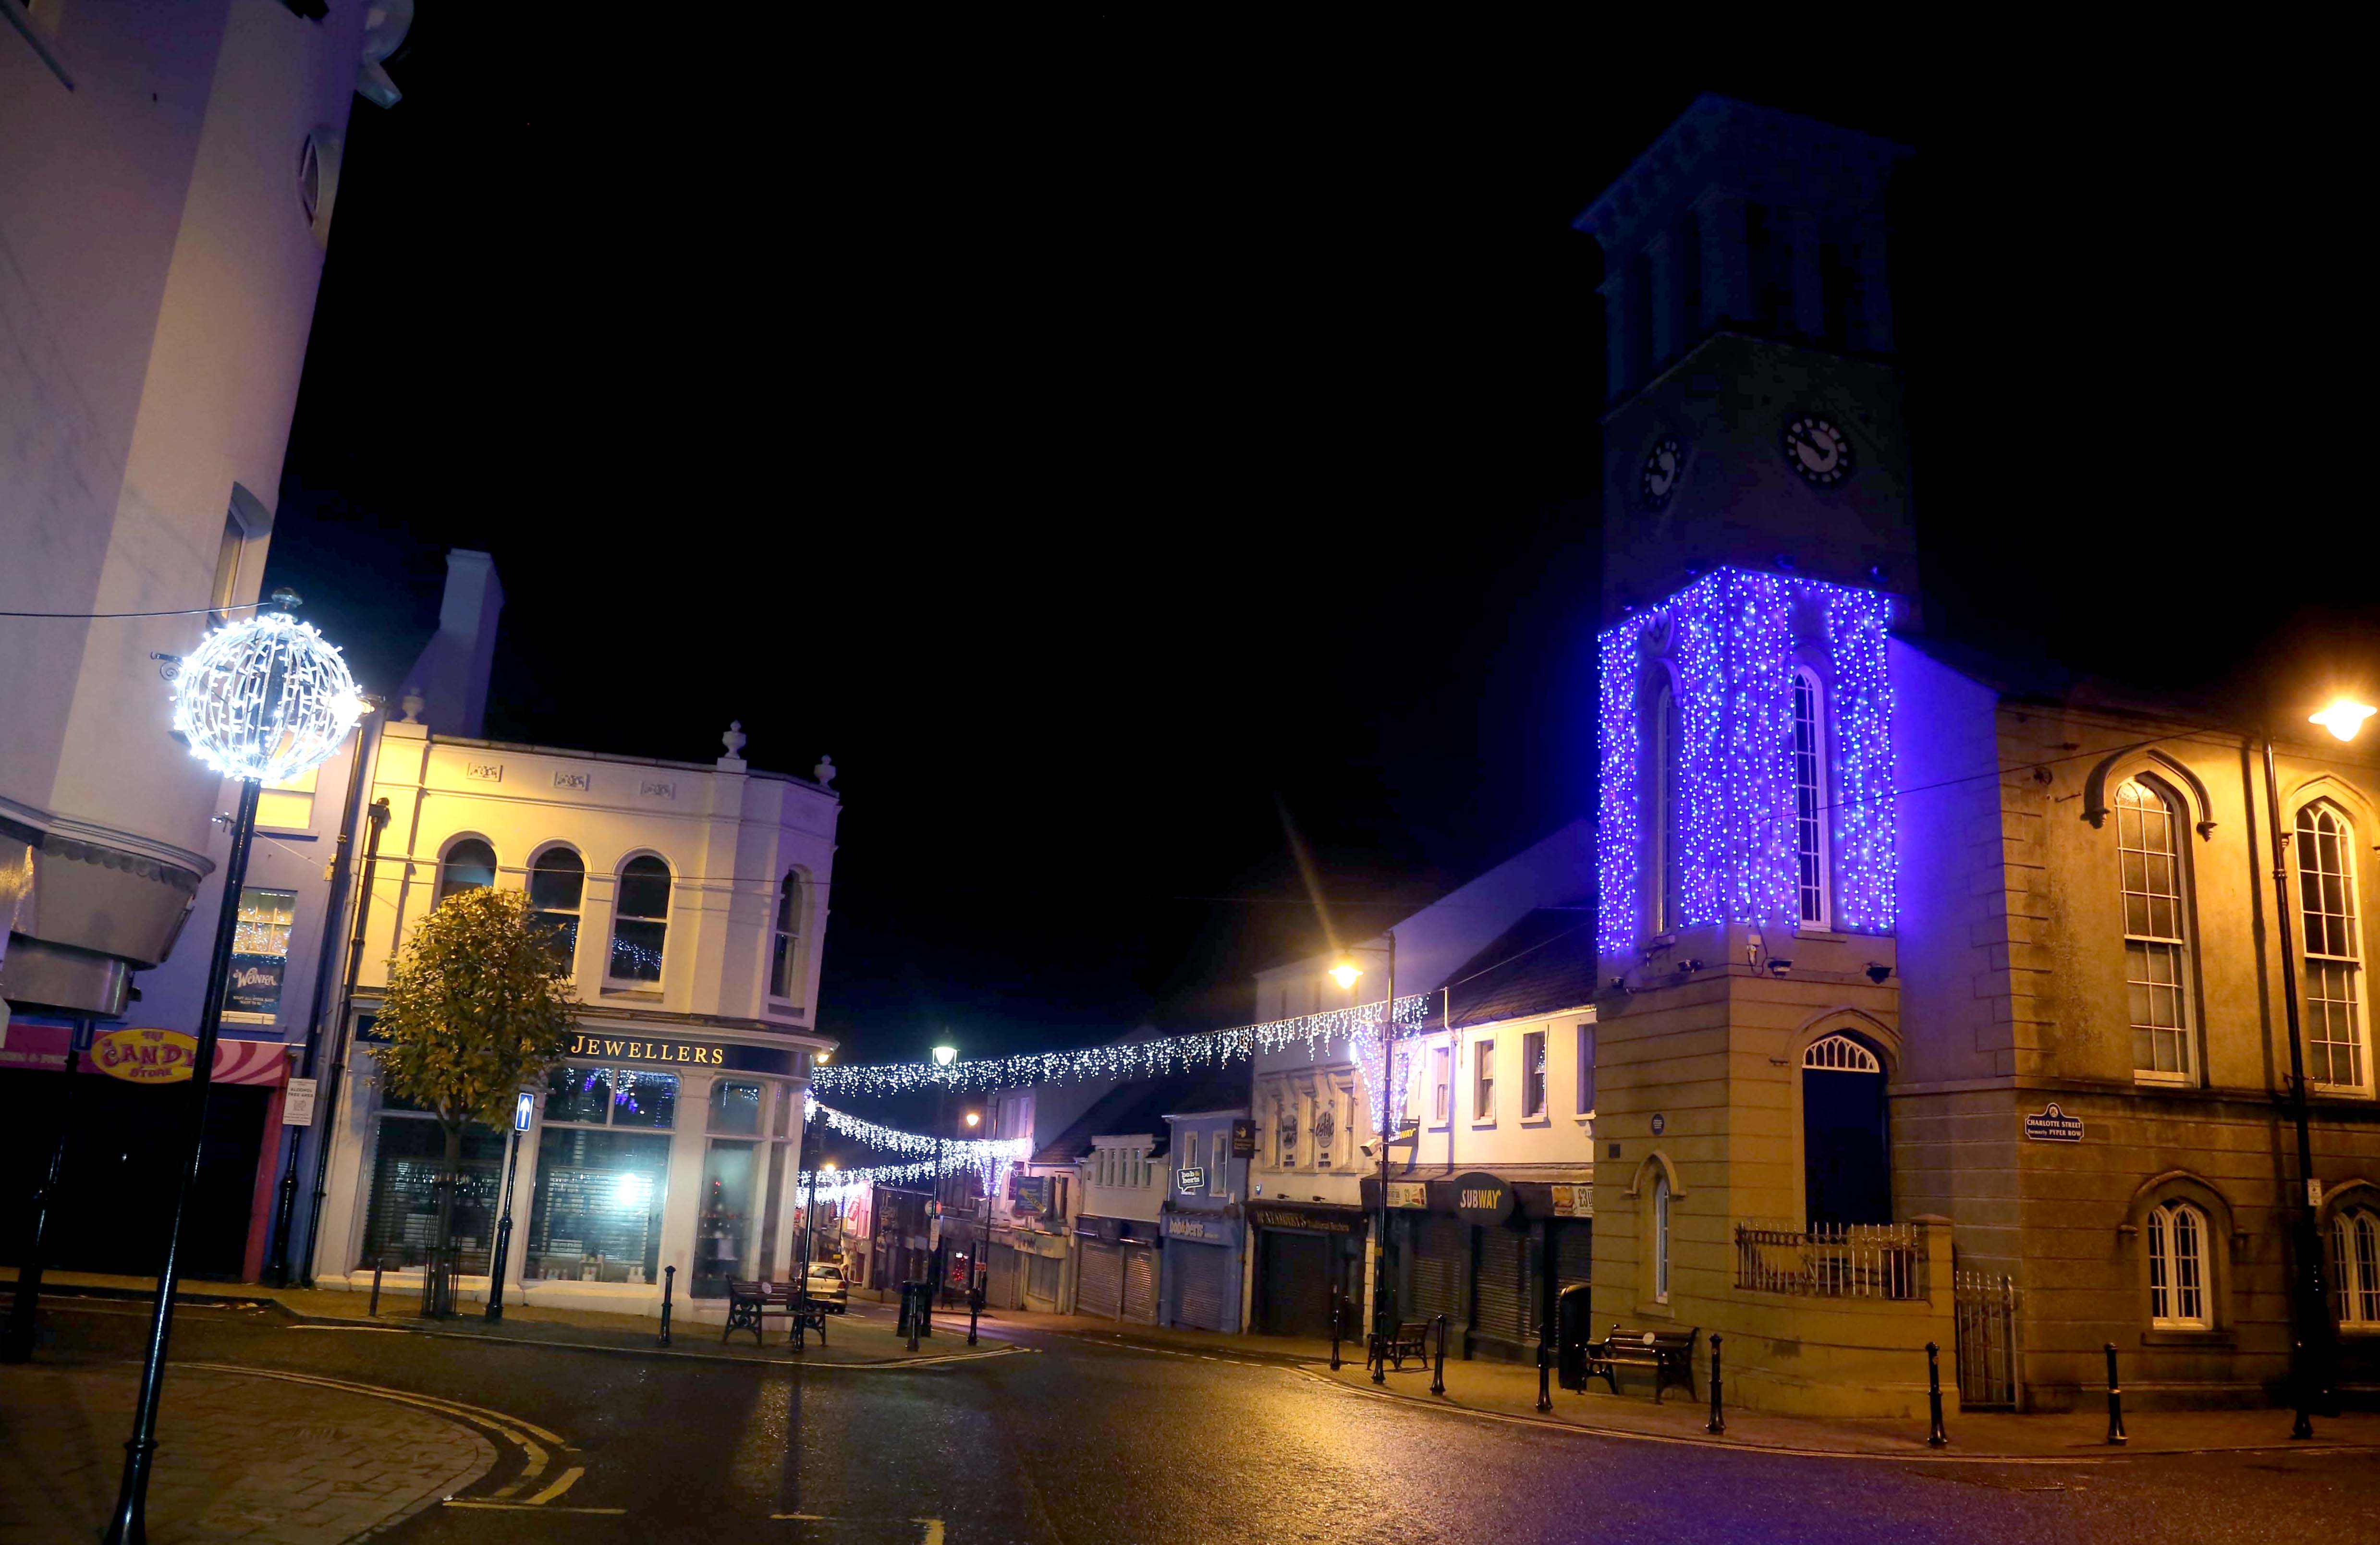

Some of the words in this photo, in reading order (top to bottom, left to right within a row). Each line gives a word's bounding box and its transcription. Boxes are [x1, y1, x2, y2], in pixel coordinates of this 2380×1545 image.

[232, 967, 277, 987] WONKA
[101, 1039, 196, 1067] CANDY
[571, 1035, 723, 1065] JEWELLERS
[129, 1067, 172, 1077] STORE
[1460, 1189, 1502, 1209] SUBWAY
